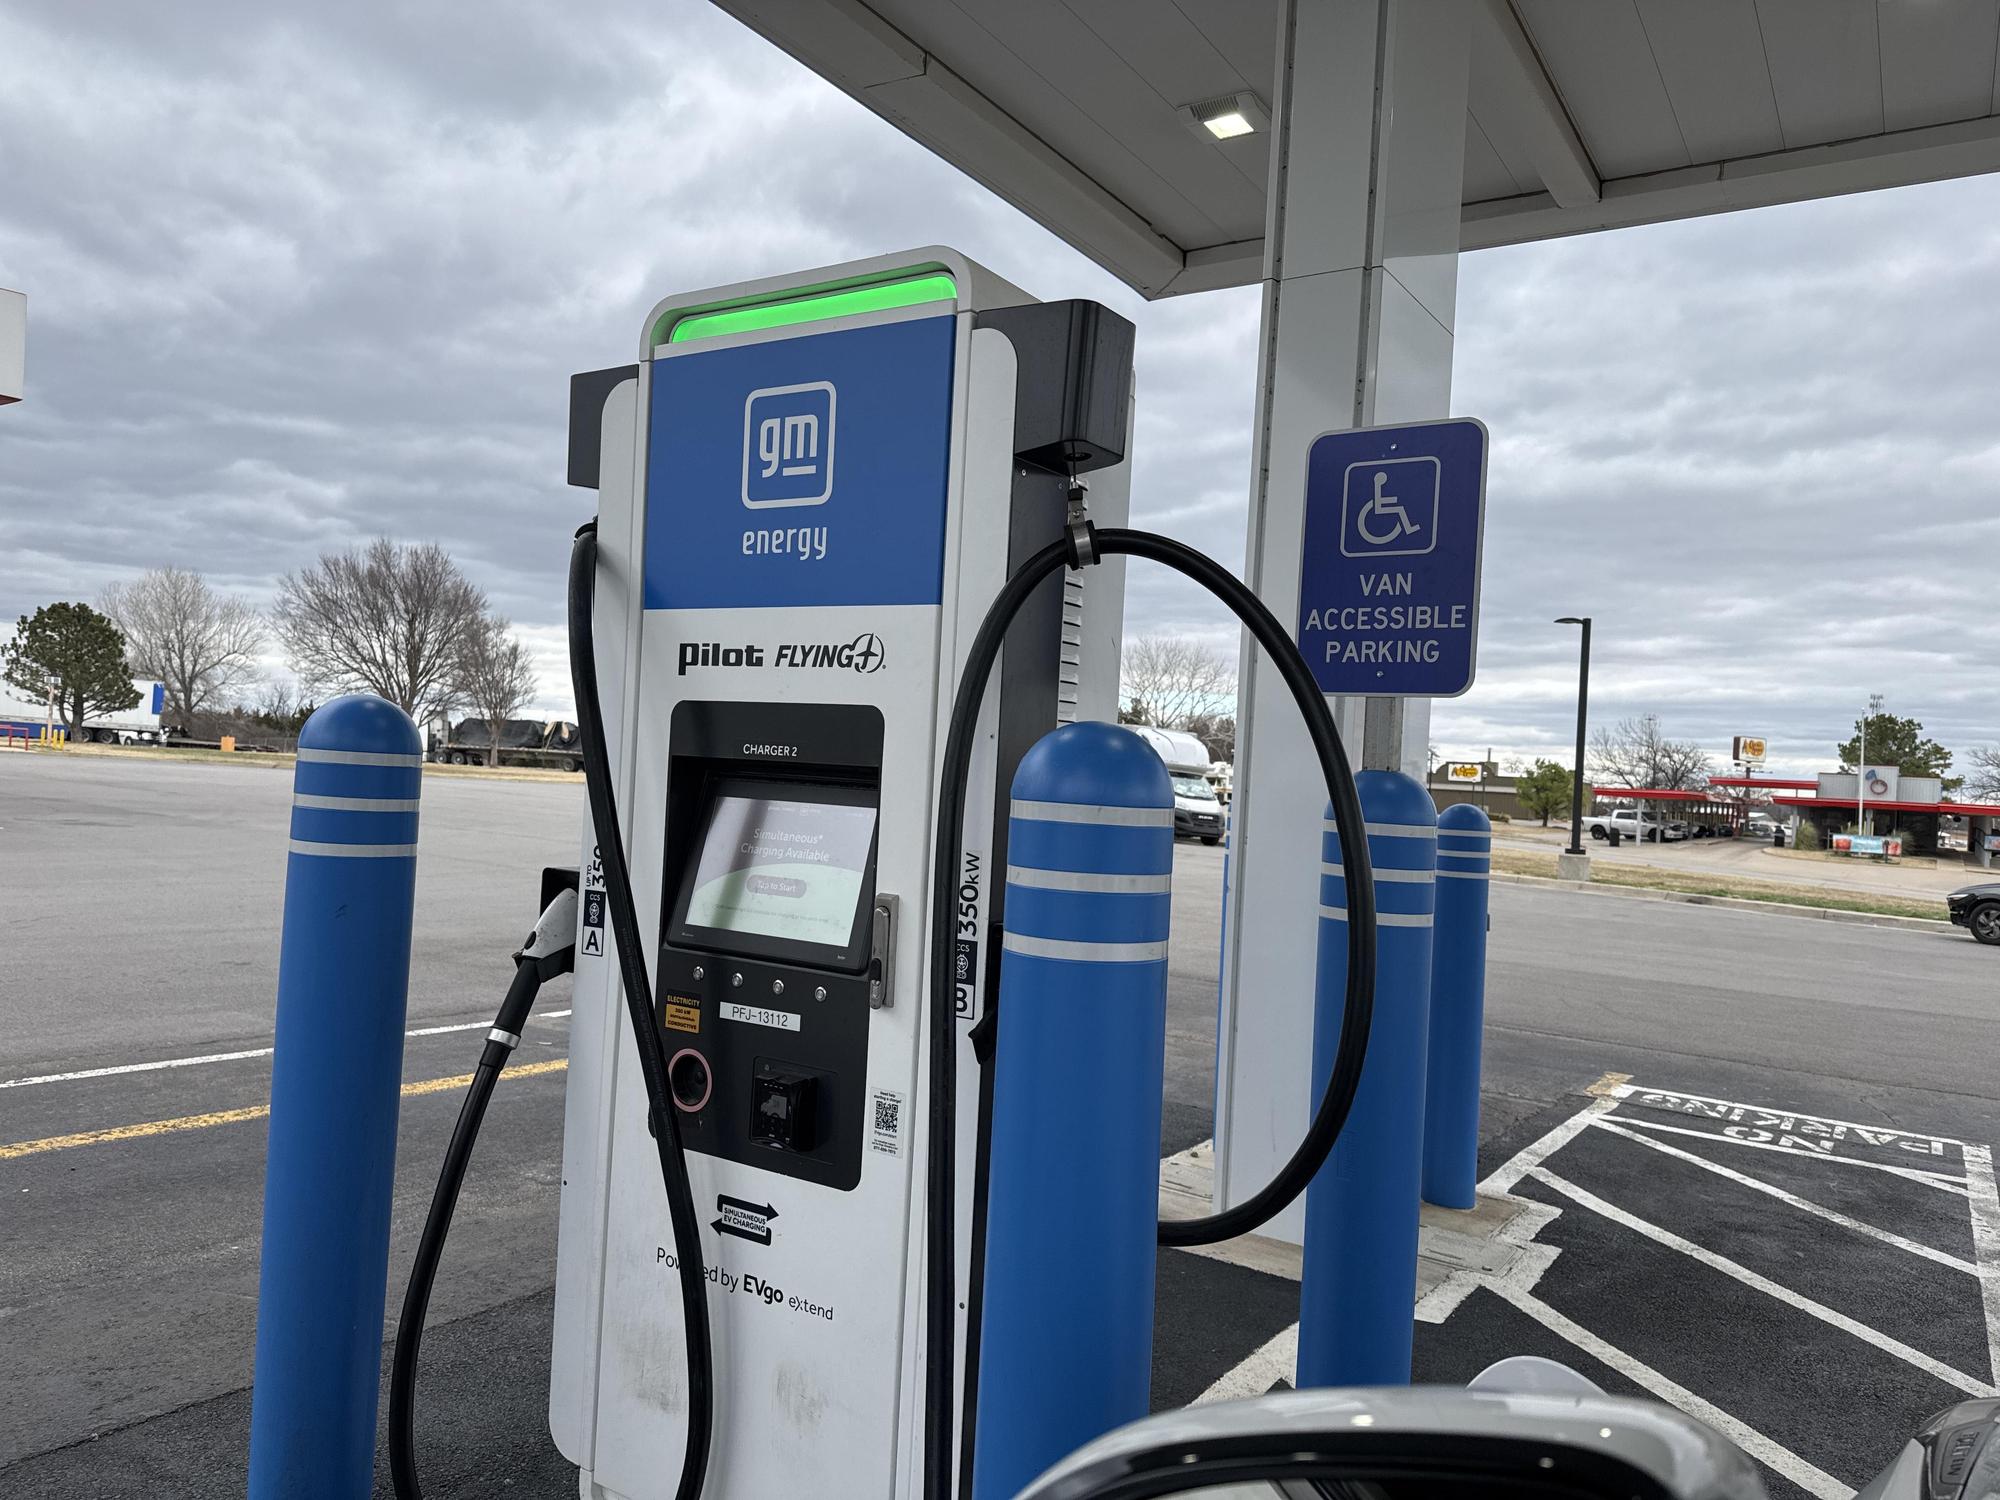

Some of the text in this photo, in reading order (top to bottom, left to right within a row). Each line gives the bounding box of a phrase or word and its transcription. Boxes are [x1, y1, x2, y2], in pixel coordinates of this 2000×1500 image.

[759, 414, 819, 478] gm
[742, 526, 828, 561] energy
[1359, 572, 1413, 597] VAN
[1304, 605, 1467, 630] ACCESSIBLE
[1325, 639, 1440, 664] PARKING
[742, 743, 798, 757] CHARGER 2
[740, 843, 831, 863] Charging Available
[590, 894, 601, 902] CCS
[779, 882, 797, 893] Start
[957, 852, 981, 937] 350kW
[585, 930, 599, 952] A
[667, 995, 700, 1007] ELECTRICITY
[731, 1006, 788, 1027] PFJ-13112
[1640, 1093, 1944, 1156] PARKING
[1722, 1125, 1835, 1155] NO
[723, 1207, 766, 1226] SIMULTANEOUS
[723, 1214, 766, 1233] EV CHARGING
[720, 1267, 739, 1293] by
[743, 1273, 784, 1305] EVgo
[788, 1296, 834, 1321] extend
